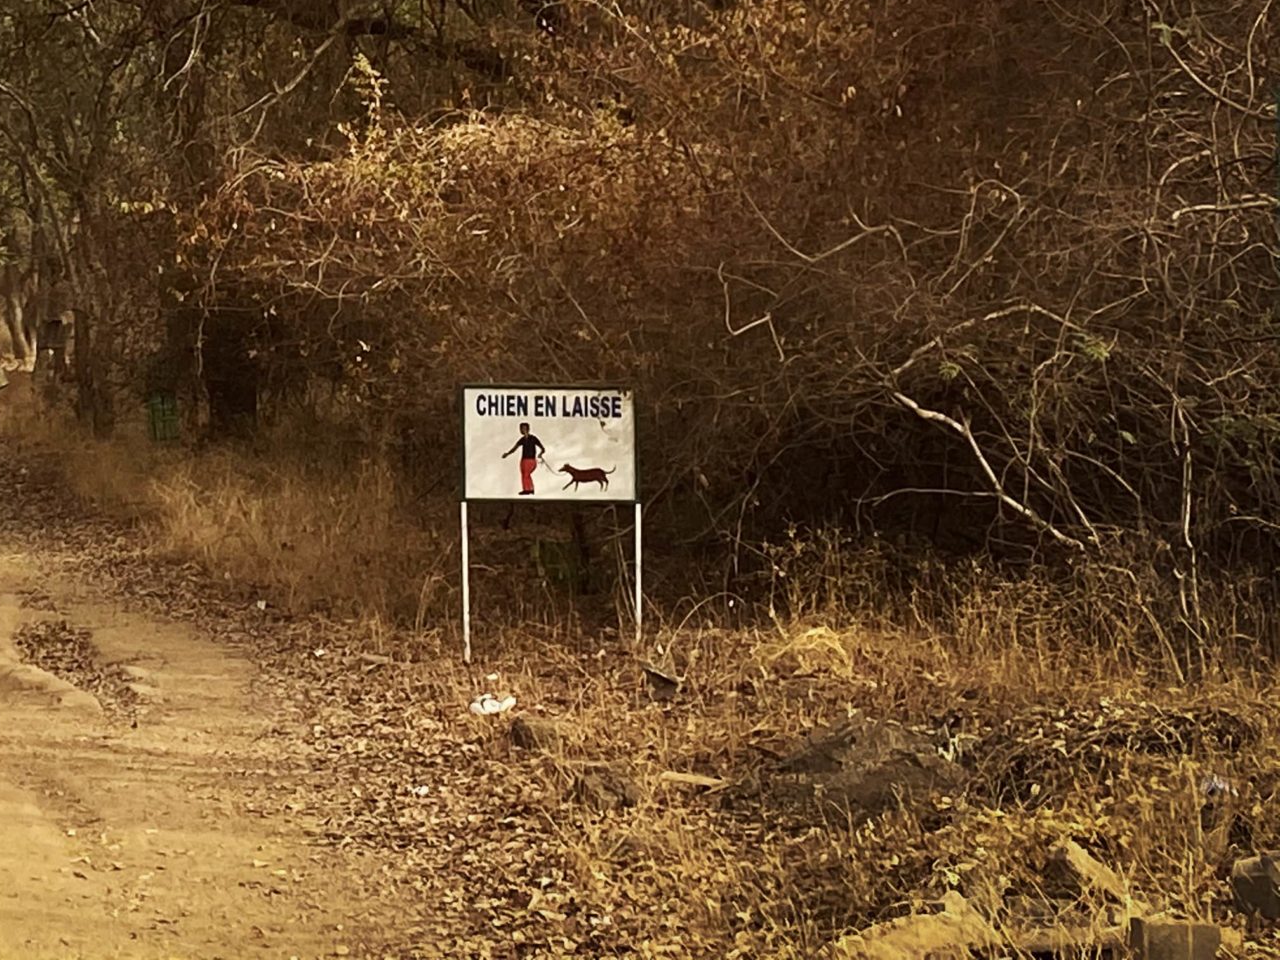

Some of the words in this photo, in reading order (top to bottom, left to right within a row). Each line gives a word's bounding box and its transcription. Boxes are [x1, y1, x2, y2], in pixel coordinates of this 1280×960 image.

[476, 394, 528, 416] CHIEN
[534, 395, 556, 417] EN
[562, 395, 622, 418] LAISSE
